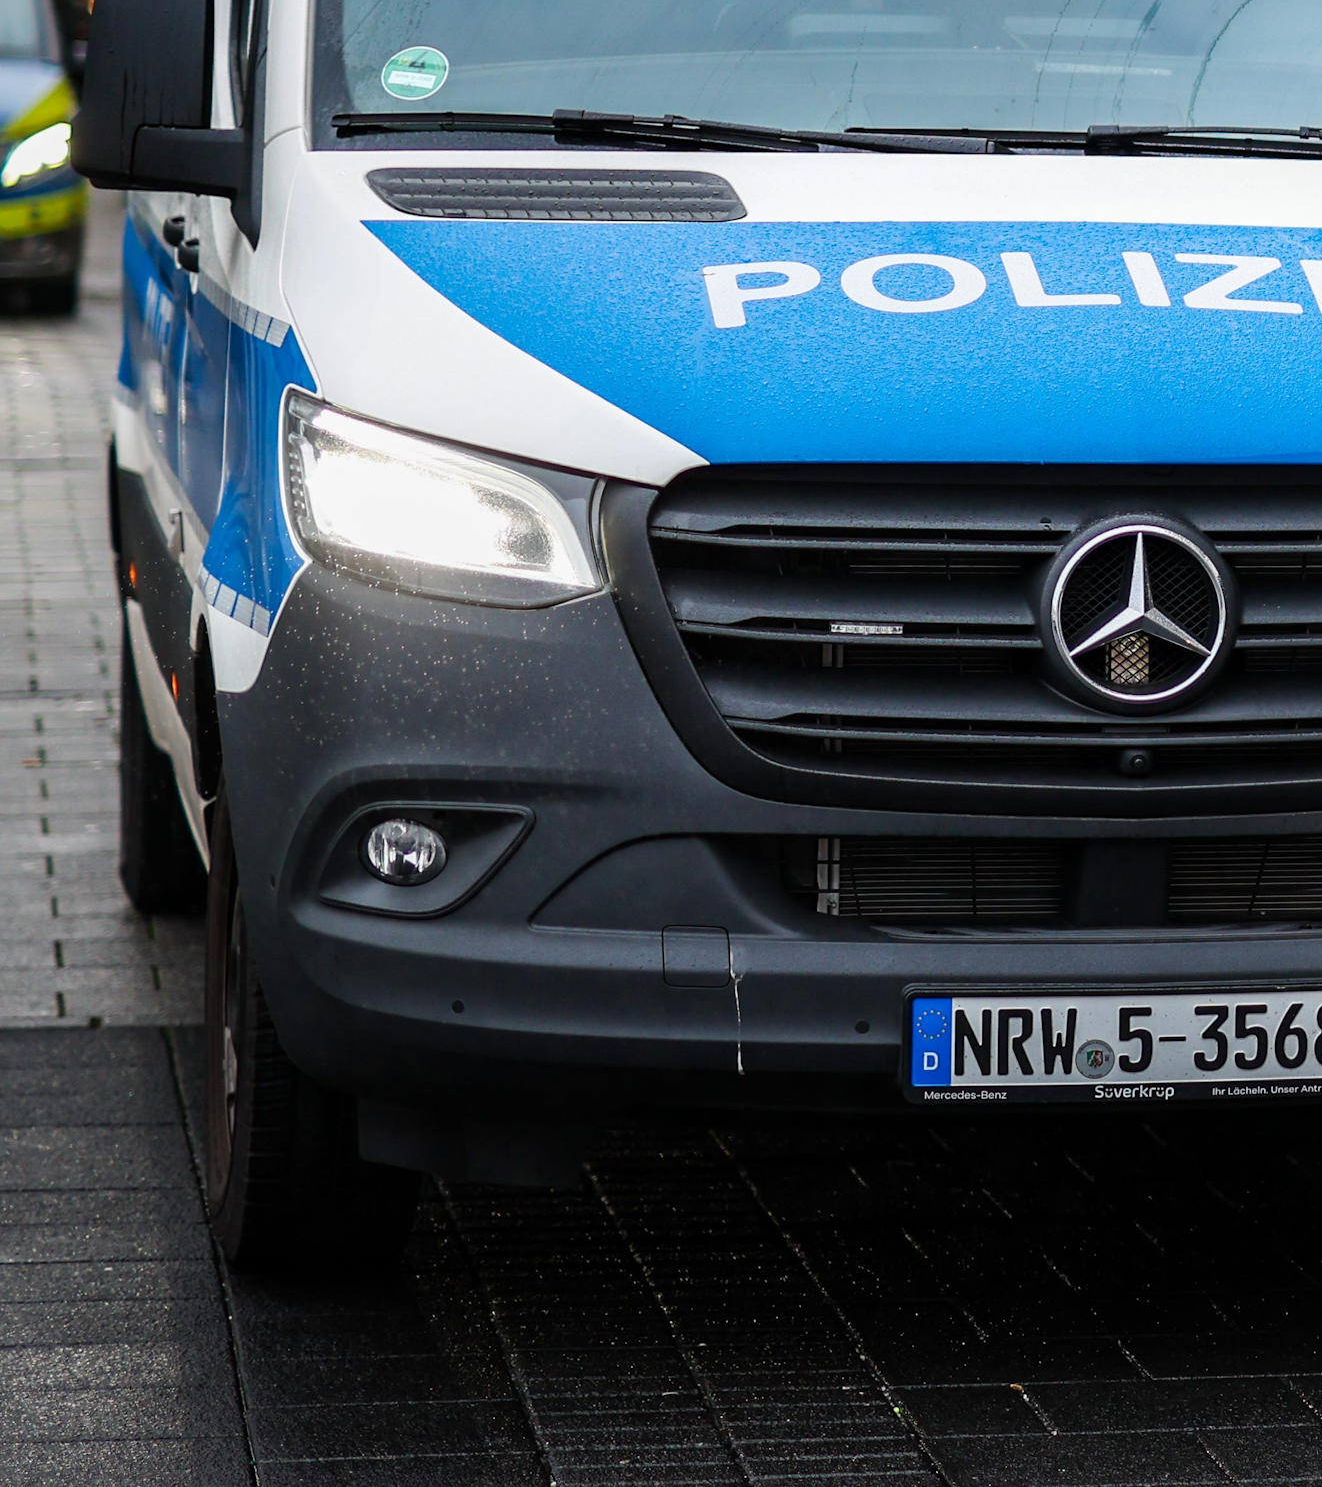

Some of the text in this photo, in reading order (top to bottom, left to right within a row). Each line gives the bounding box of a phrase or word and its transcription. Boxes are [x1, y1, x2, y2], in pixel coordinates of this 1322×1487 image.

[953, 1007, 1078, 1076] NRW
[923, 1051, 939, 1071] D
[923, 1090, 1008, 1101] Mercedes-Benz
[1094, 1084, 1175, 1101] Süverkrüp
[1212, 1086, 1226, 1096] Ihr
[1227, 1085, 1269, 1096] Lächeln.
[1270, 1084, 1299, 1095] Unser
